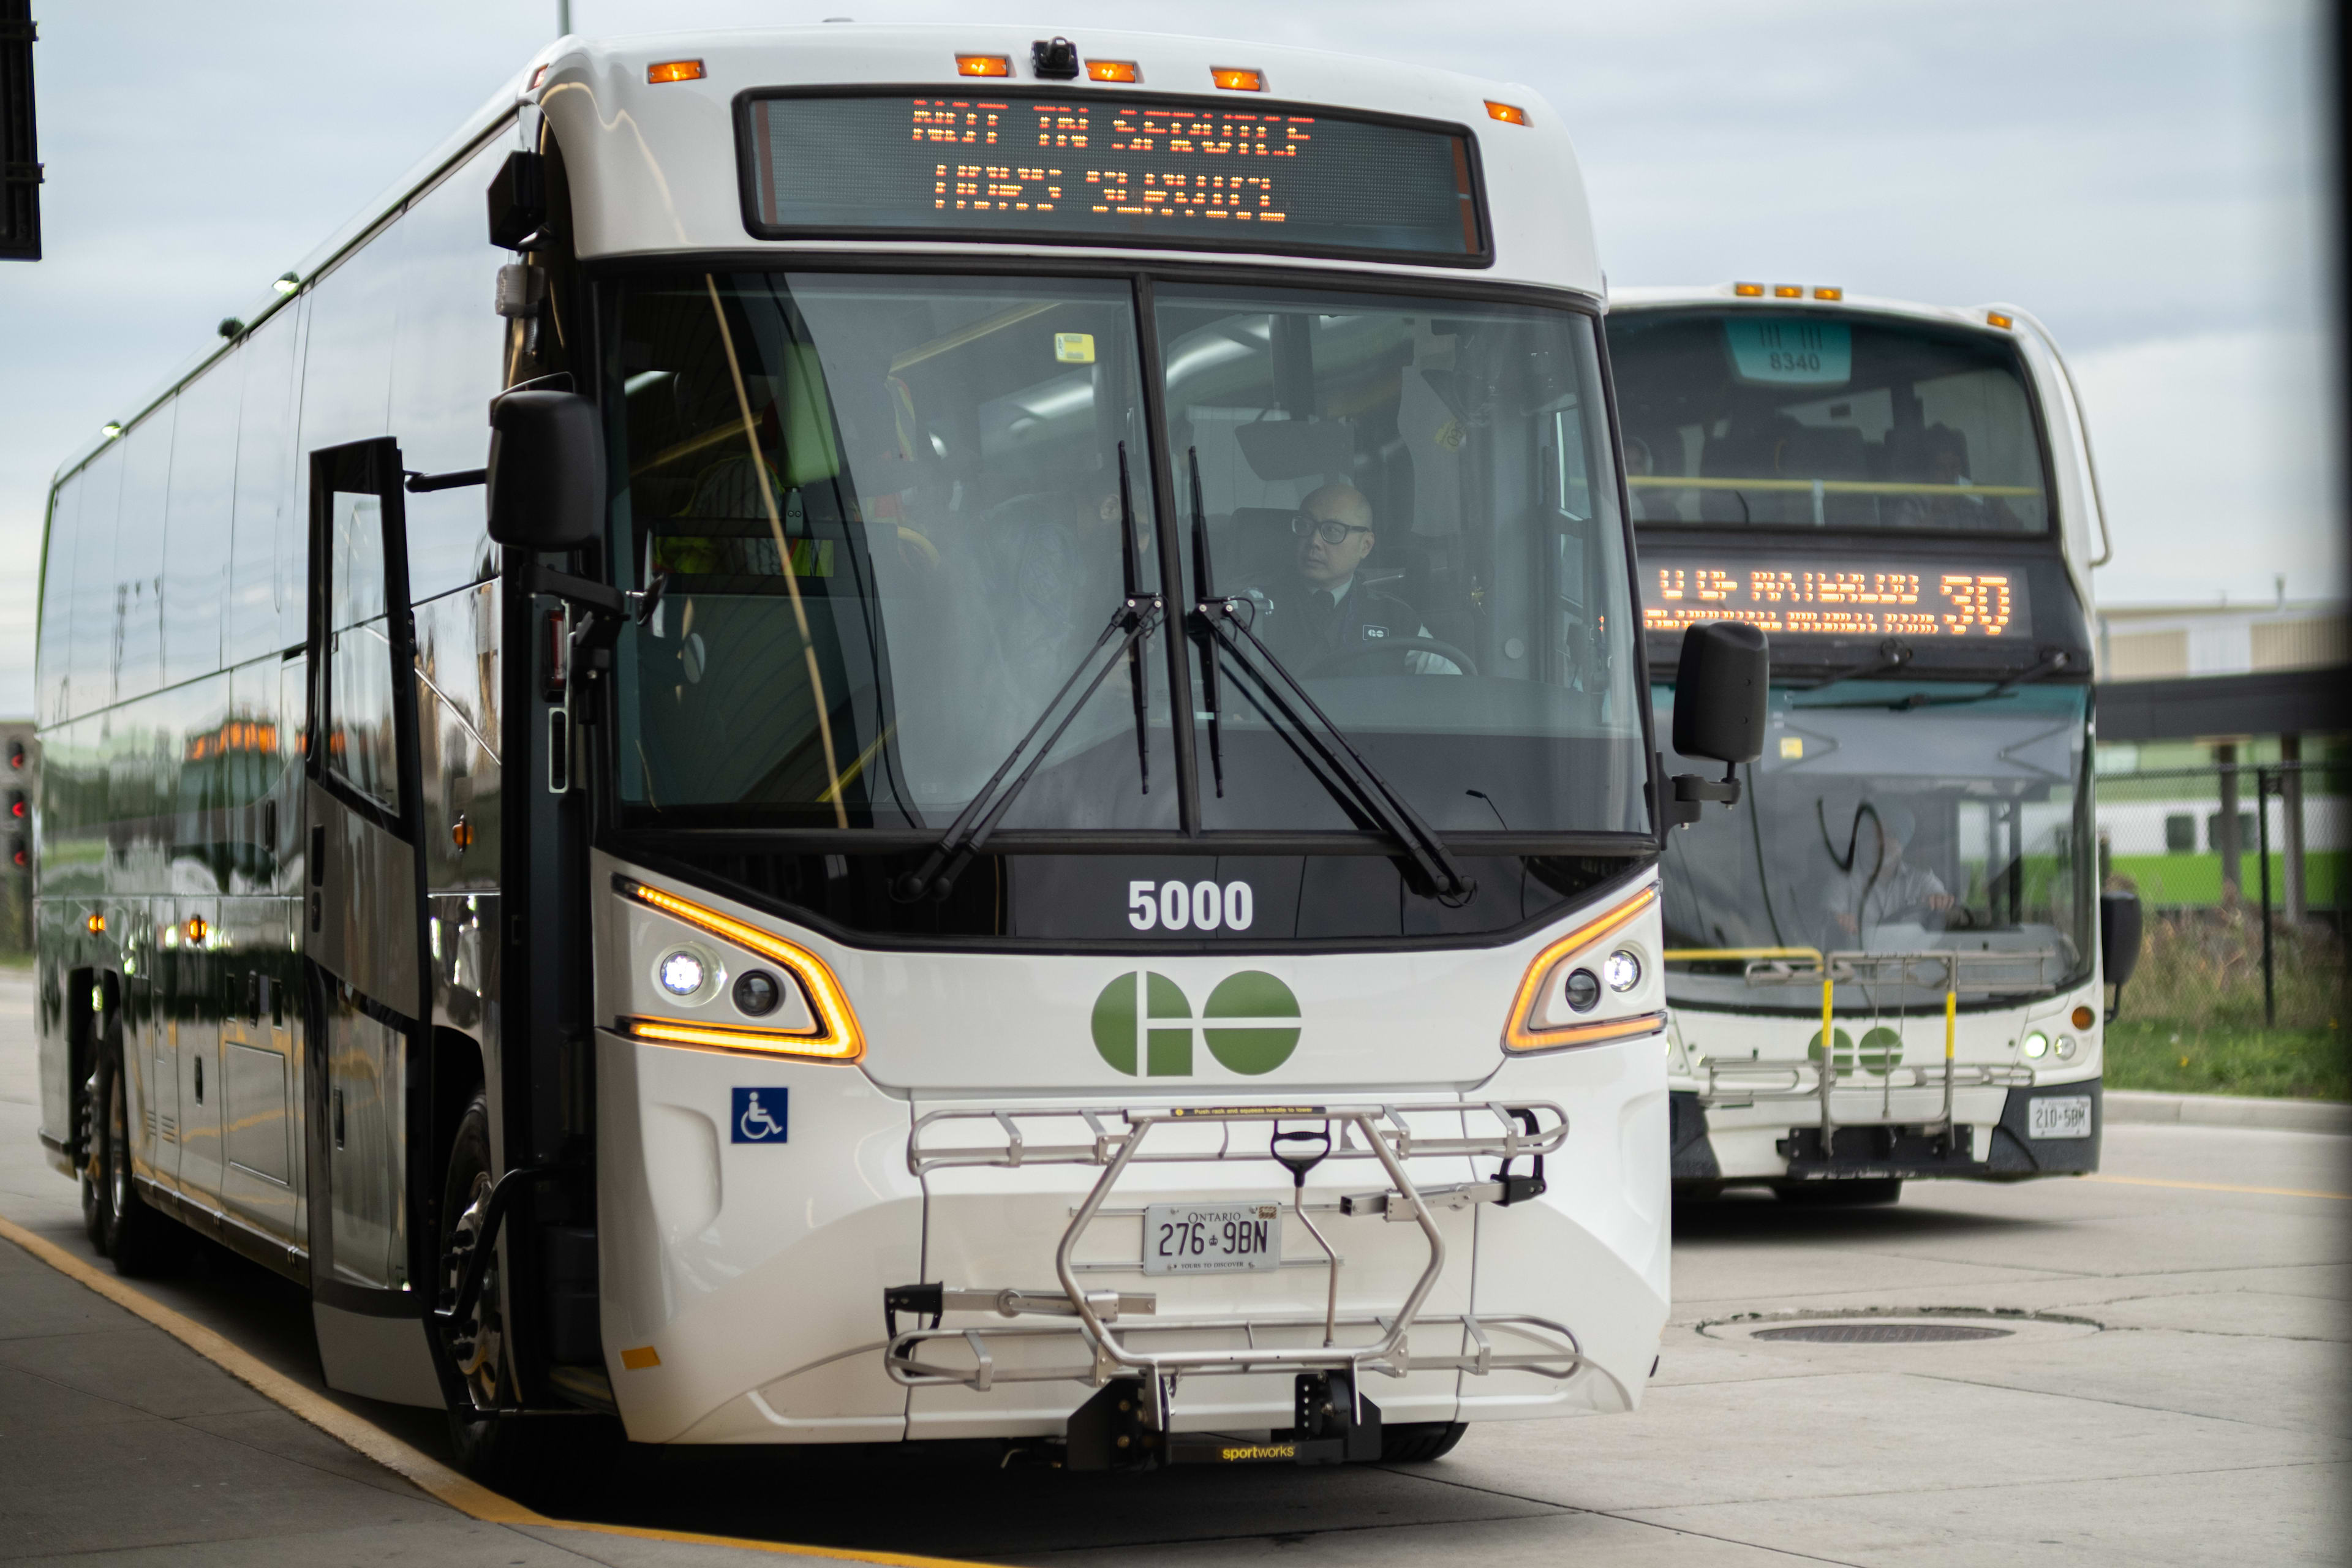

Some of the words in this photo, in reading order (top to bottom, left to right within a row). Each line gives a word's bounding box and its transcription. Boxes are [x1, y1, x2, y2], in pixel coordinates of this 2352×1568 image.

[1770, 352, 1822, 373] 8340
[1939, 575, 2011, 636] 30
[1128, 880, 1253, 930] 5000
[1091, 970, 1302, 1077] GO
[1187, 1212, 1242, 1224] ONTARIO
[1159, 1222, 1205, 1256] 276
[1223, 1220, 1268, 1254] 9BN
[1222, 1446, 1295, 1462] sportworks
